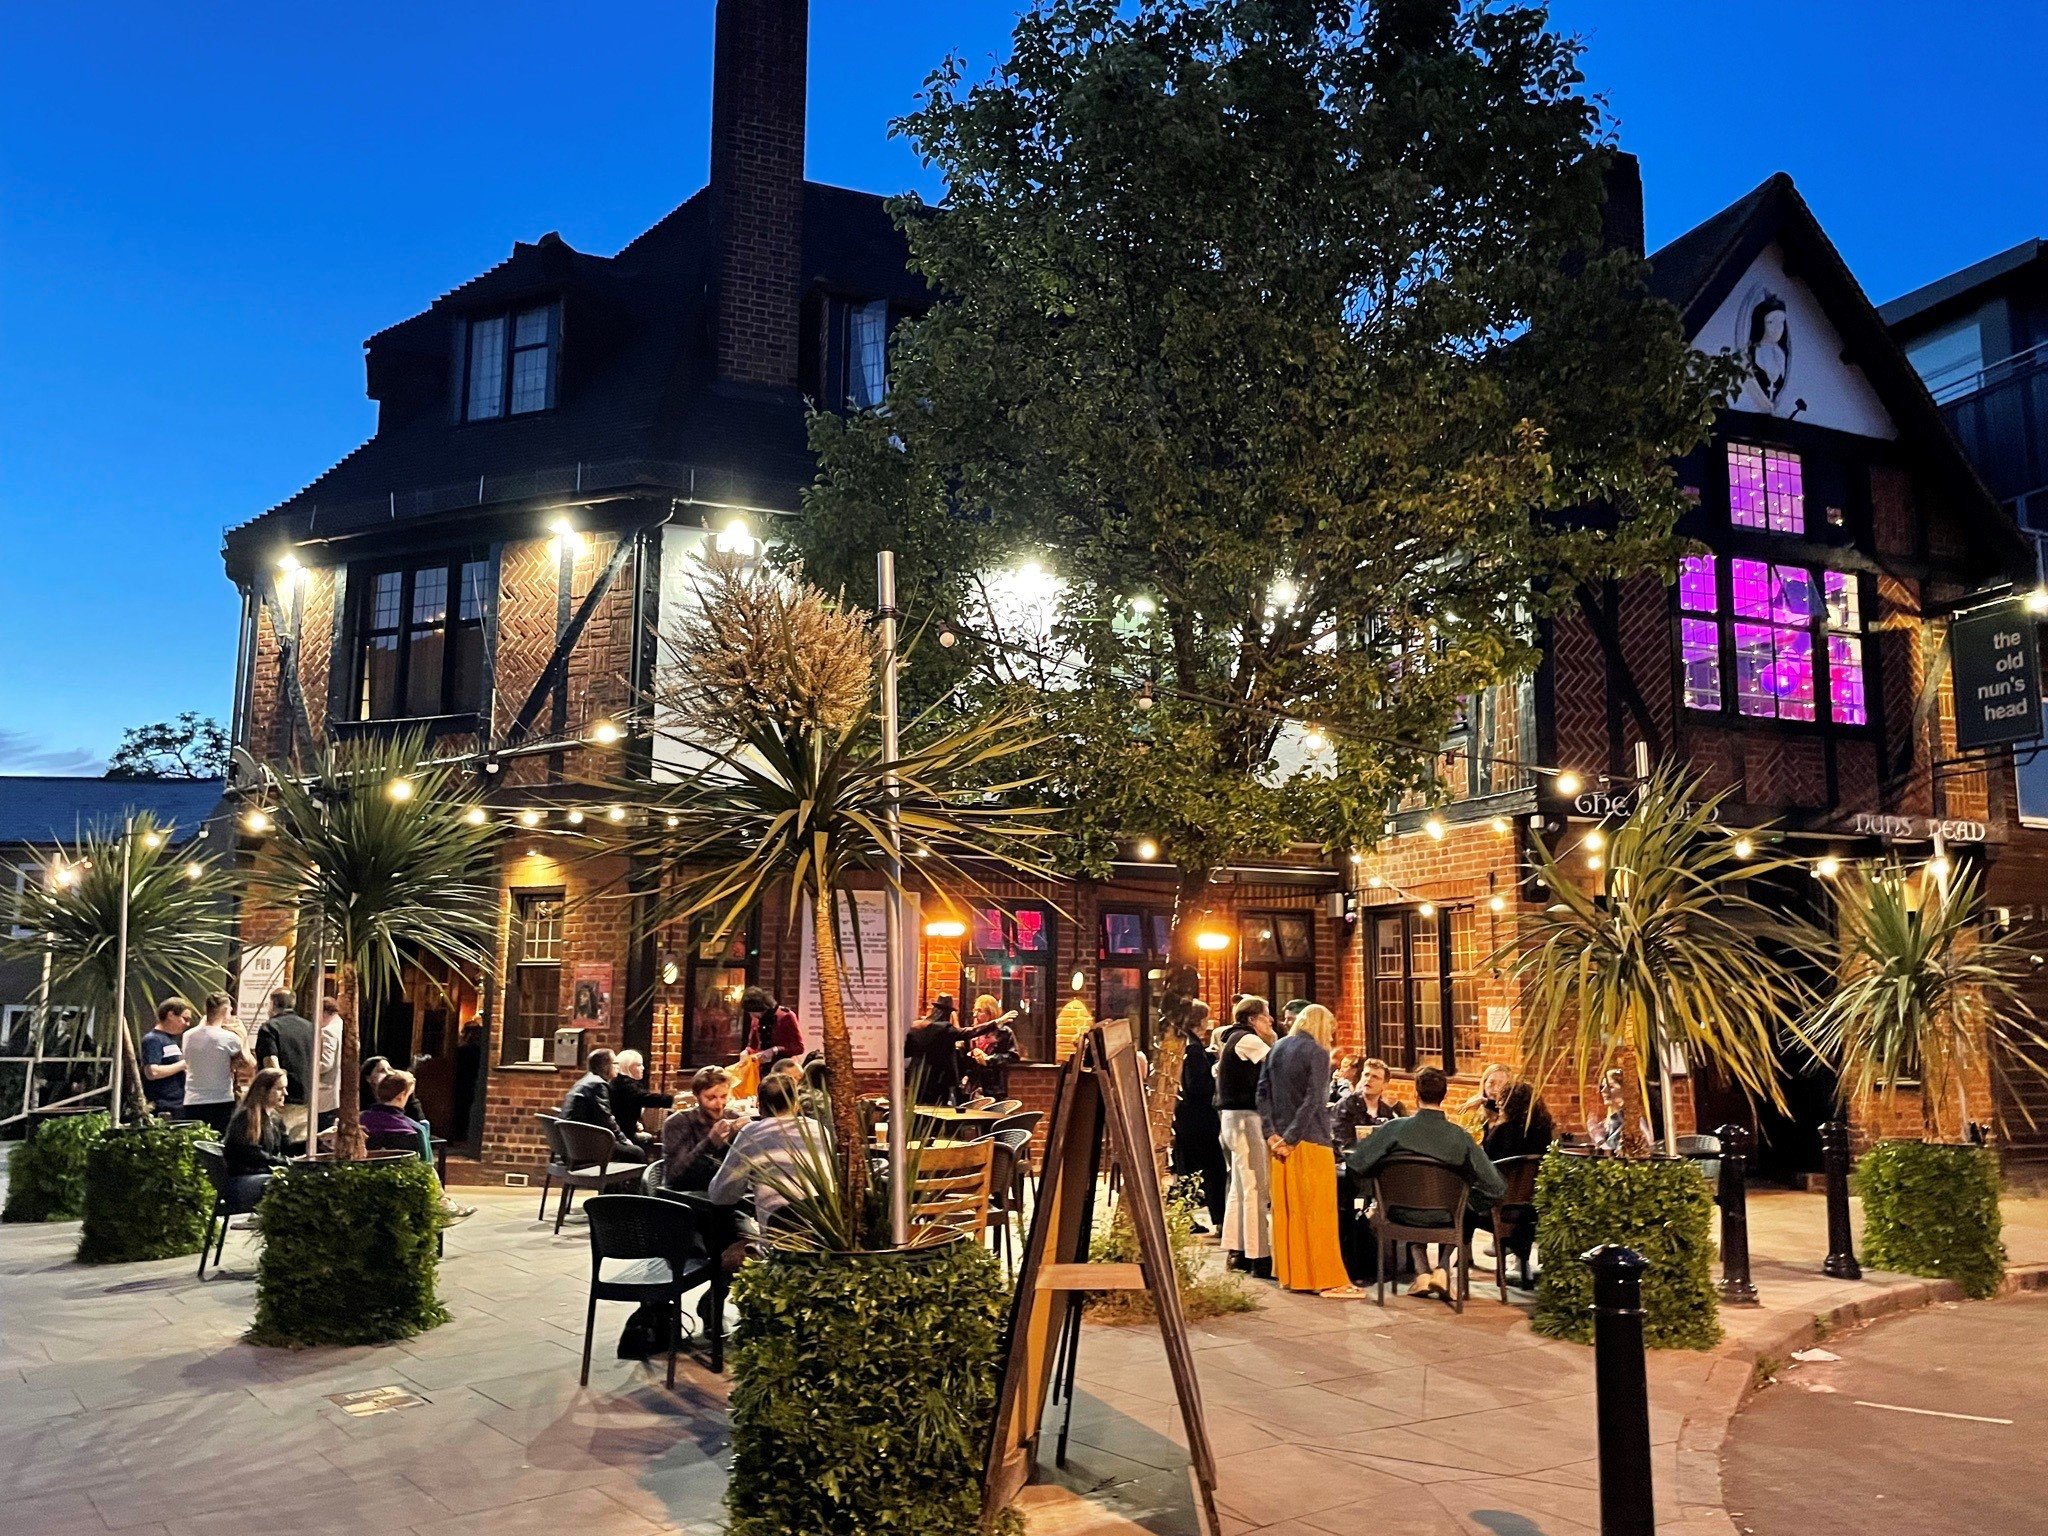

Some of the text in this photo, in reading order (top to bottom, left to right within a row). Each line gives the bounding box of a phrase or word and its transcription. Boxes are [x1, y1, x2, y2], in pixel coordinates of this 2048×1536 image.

[1993, 631, 2021, 650] the
[1995, 651, 2024, 673] old
[1977, 676, 2026, 700] nun's
[1984, 697, 2028, 721] head
[255, 958, 271, 971] PUB
